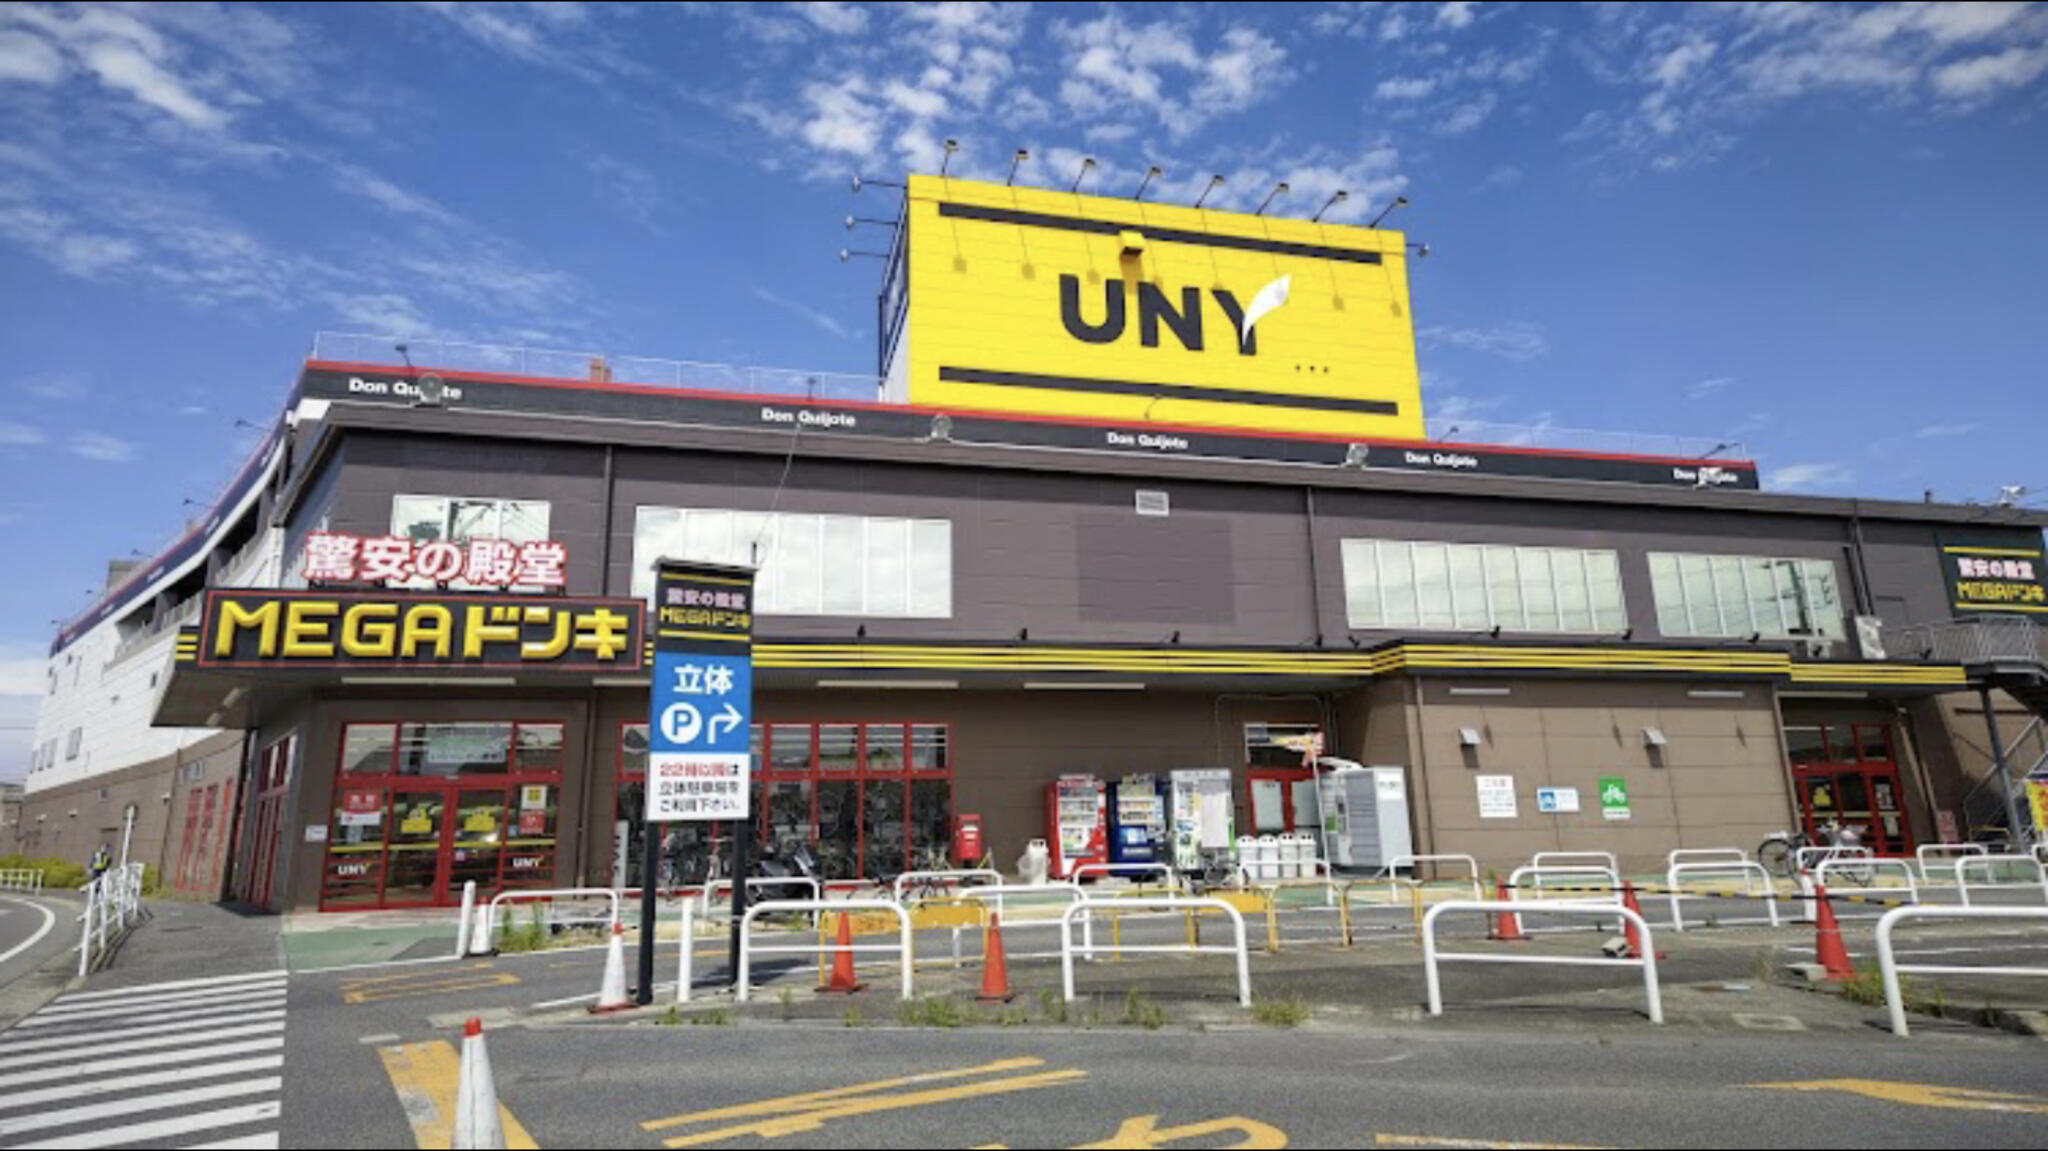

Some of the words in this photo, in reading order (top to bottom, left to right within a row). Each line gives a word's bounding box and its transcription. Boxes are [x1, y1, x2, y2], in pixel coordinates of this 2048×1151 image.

[1059, 273, 1290, 356] UNY
[348, 377, 388, 394] Don
[761, 406, 794, 422] Don
[797, 409, 856, 427] Quijote
[1107, 431, 1134, 445] Don
[1138, 434, 1188, 449] Quijote
[1405, 451, 1431, 463] Don
[1433, 453, 1478, 468] Quijote
[1673, 467, 1696, 480] Don
[303, 532, 568, 586] 驚安の殿堂
[672, 664, 735, 695] 立体
[338, 862, 370, 875] UNY
[513, 856, 543, 868] UNY
